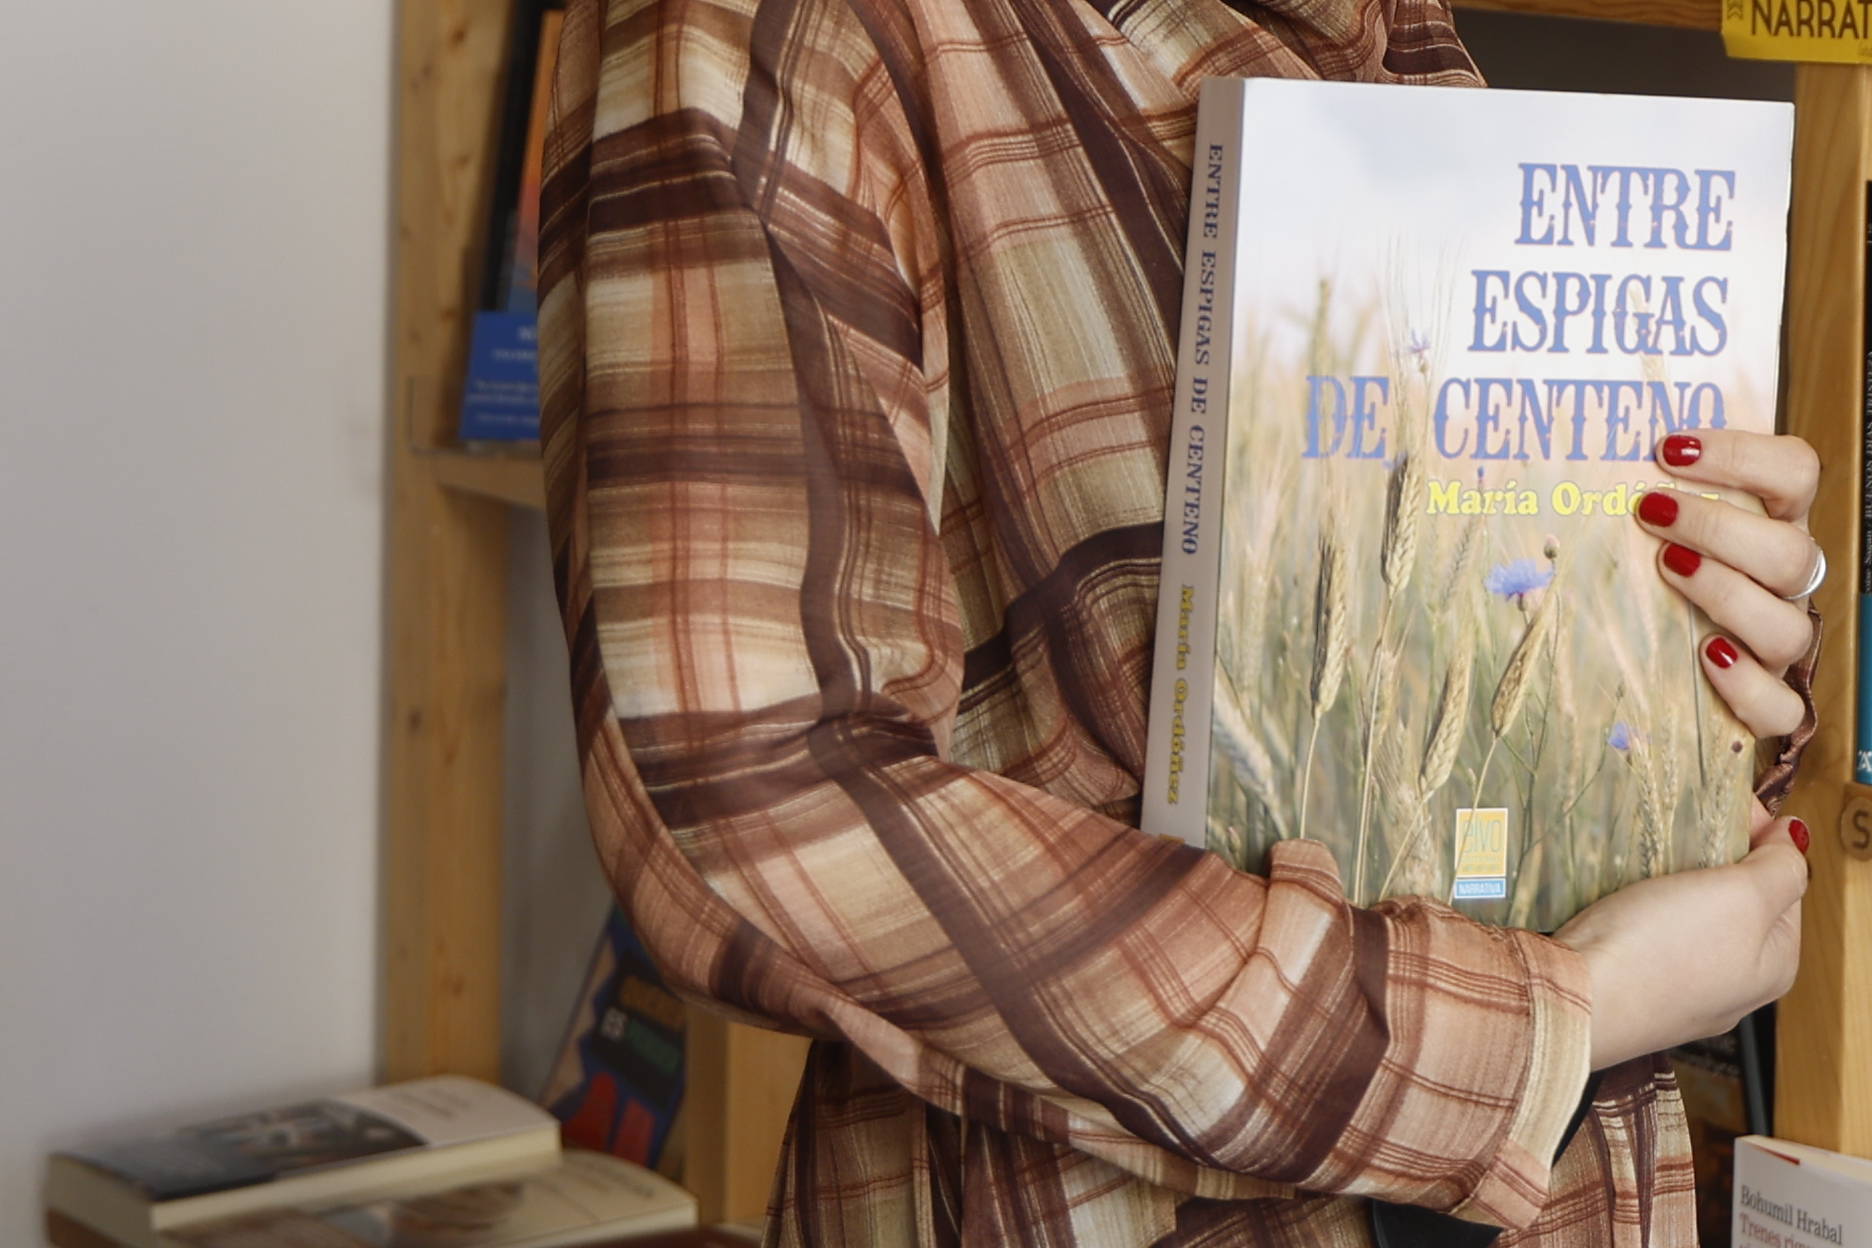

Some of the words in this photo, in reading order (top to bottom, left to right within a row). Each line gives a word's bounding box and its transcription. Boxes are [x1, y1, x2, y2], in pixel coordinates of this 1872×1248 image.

[1201, 143, 1225, 239] ENTRE
[1514, 161, 1737, 252] ENTRE
[1192, 251, 1217, 366] ESPIGAS
[1467, 269, 1729, 358] ESPIGAS
[1190, 376, 1208, 413] DE
[1300, 375, 1390, 461] DE
[1433, 376, 1729, 463] CENTENO
[1181, 424, 1208, 554] CENTENO
[1426, 480, 1539, 518] María
[1176, 584, 1195, 671] María
[1852, 809, 1871, 850] S
[1740, 1184, 1795, 1227] Bohumil
[1796, 1207, 1843, 1246] Hrabal
